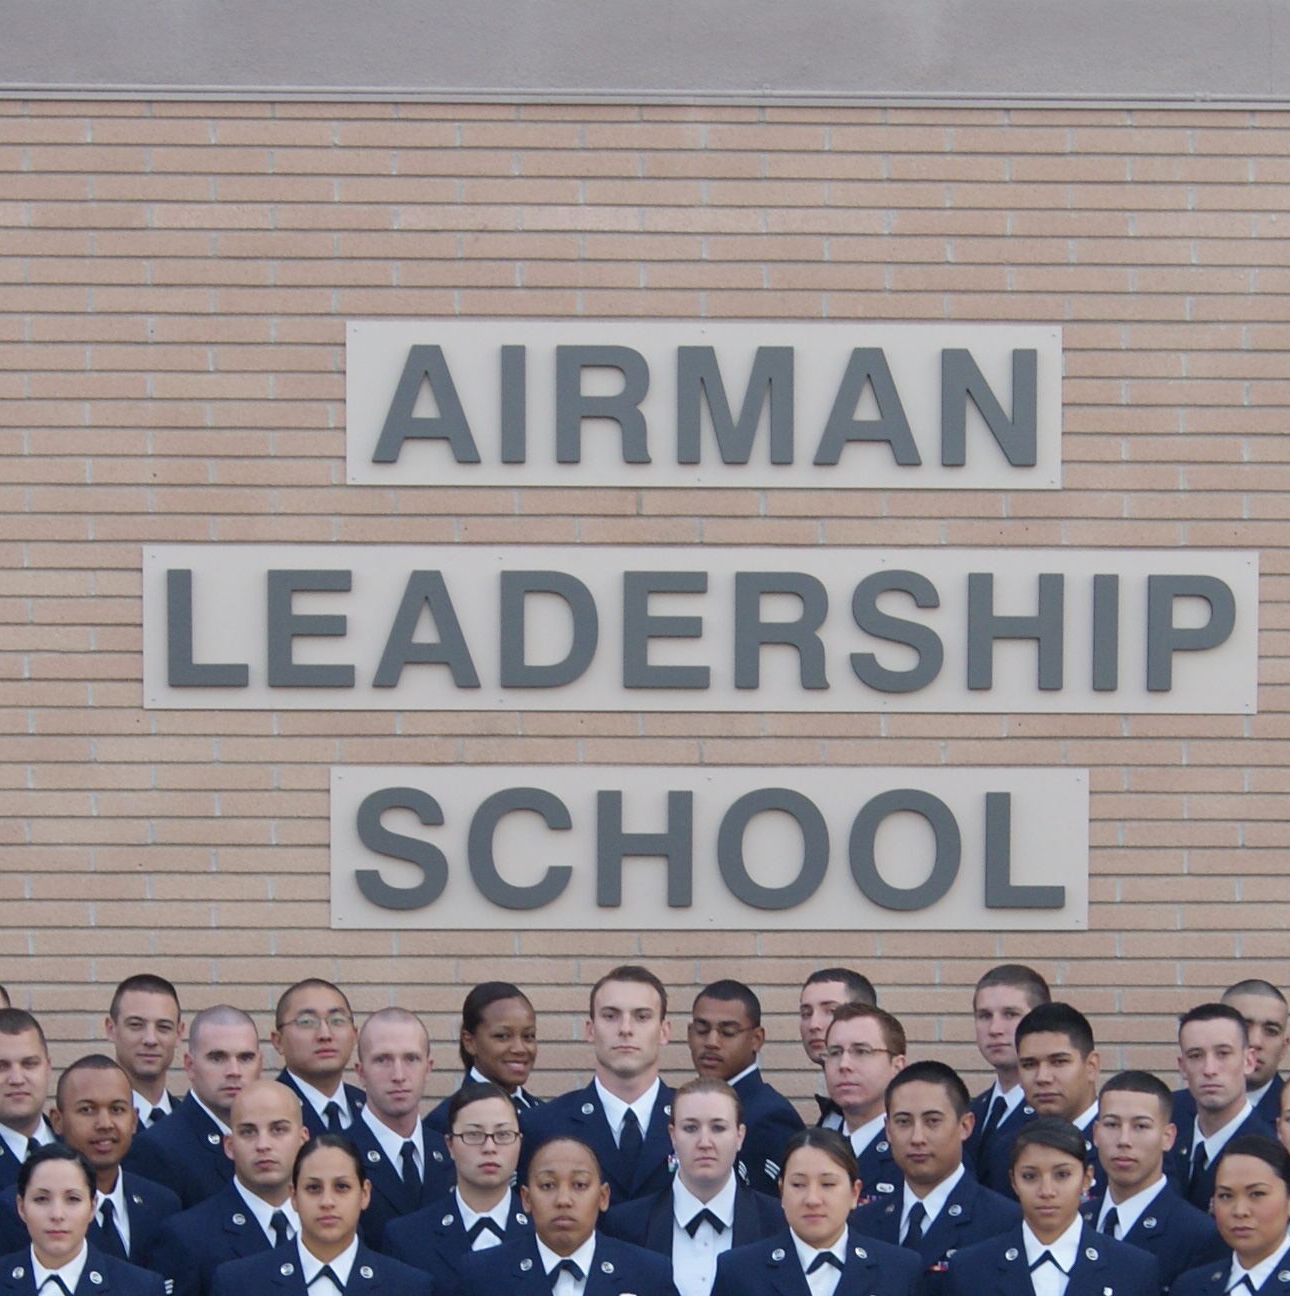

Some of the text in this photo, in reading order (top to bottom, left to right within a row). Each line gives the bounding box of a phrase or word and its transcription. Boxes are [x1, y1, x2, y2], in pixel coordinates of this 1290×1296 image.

[372, 344, 1037, 467] AIRMAN
[166, 568, 1237, 694] LEADERSHIP
[354, 786, 1066, 912] SCHOOL
